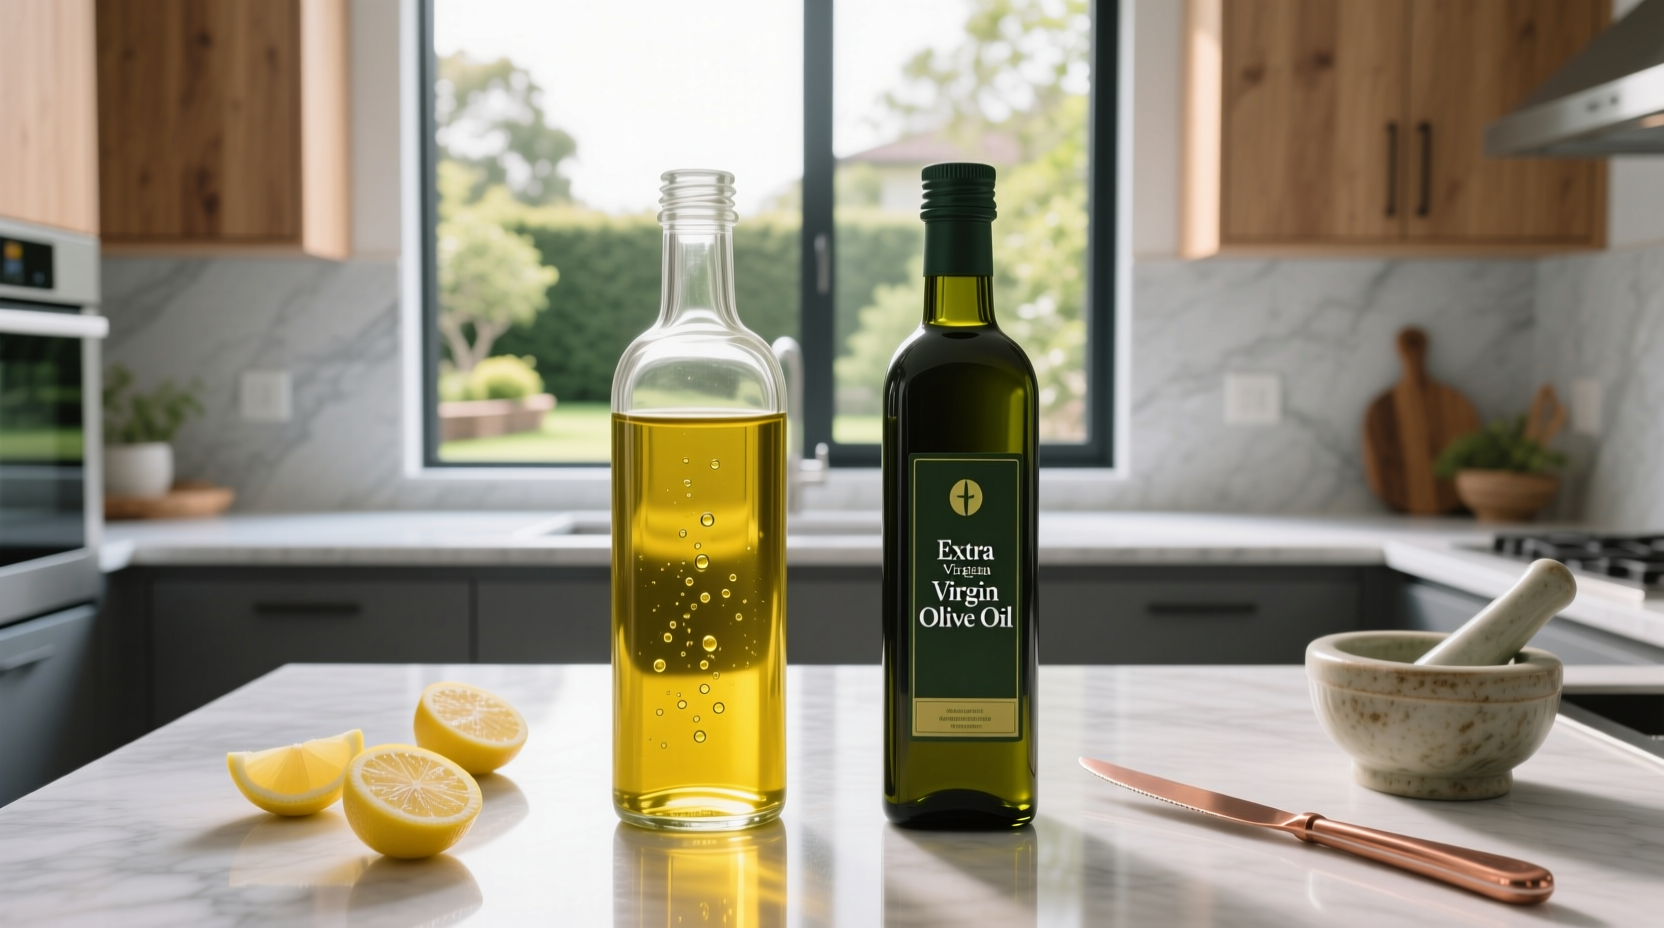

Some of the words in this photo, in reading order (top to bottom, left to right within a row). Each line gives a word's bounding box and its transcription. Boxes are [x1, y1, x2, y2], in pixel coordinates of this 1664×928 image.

[937, 539, 995, 560] Extra
[931, 581, 999, 608] Virgin
[919, 605, 976, 628] Olive
[980, 605, 1013, 628] Oil
